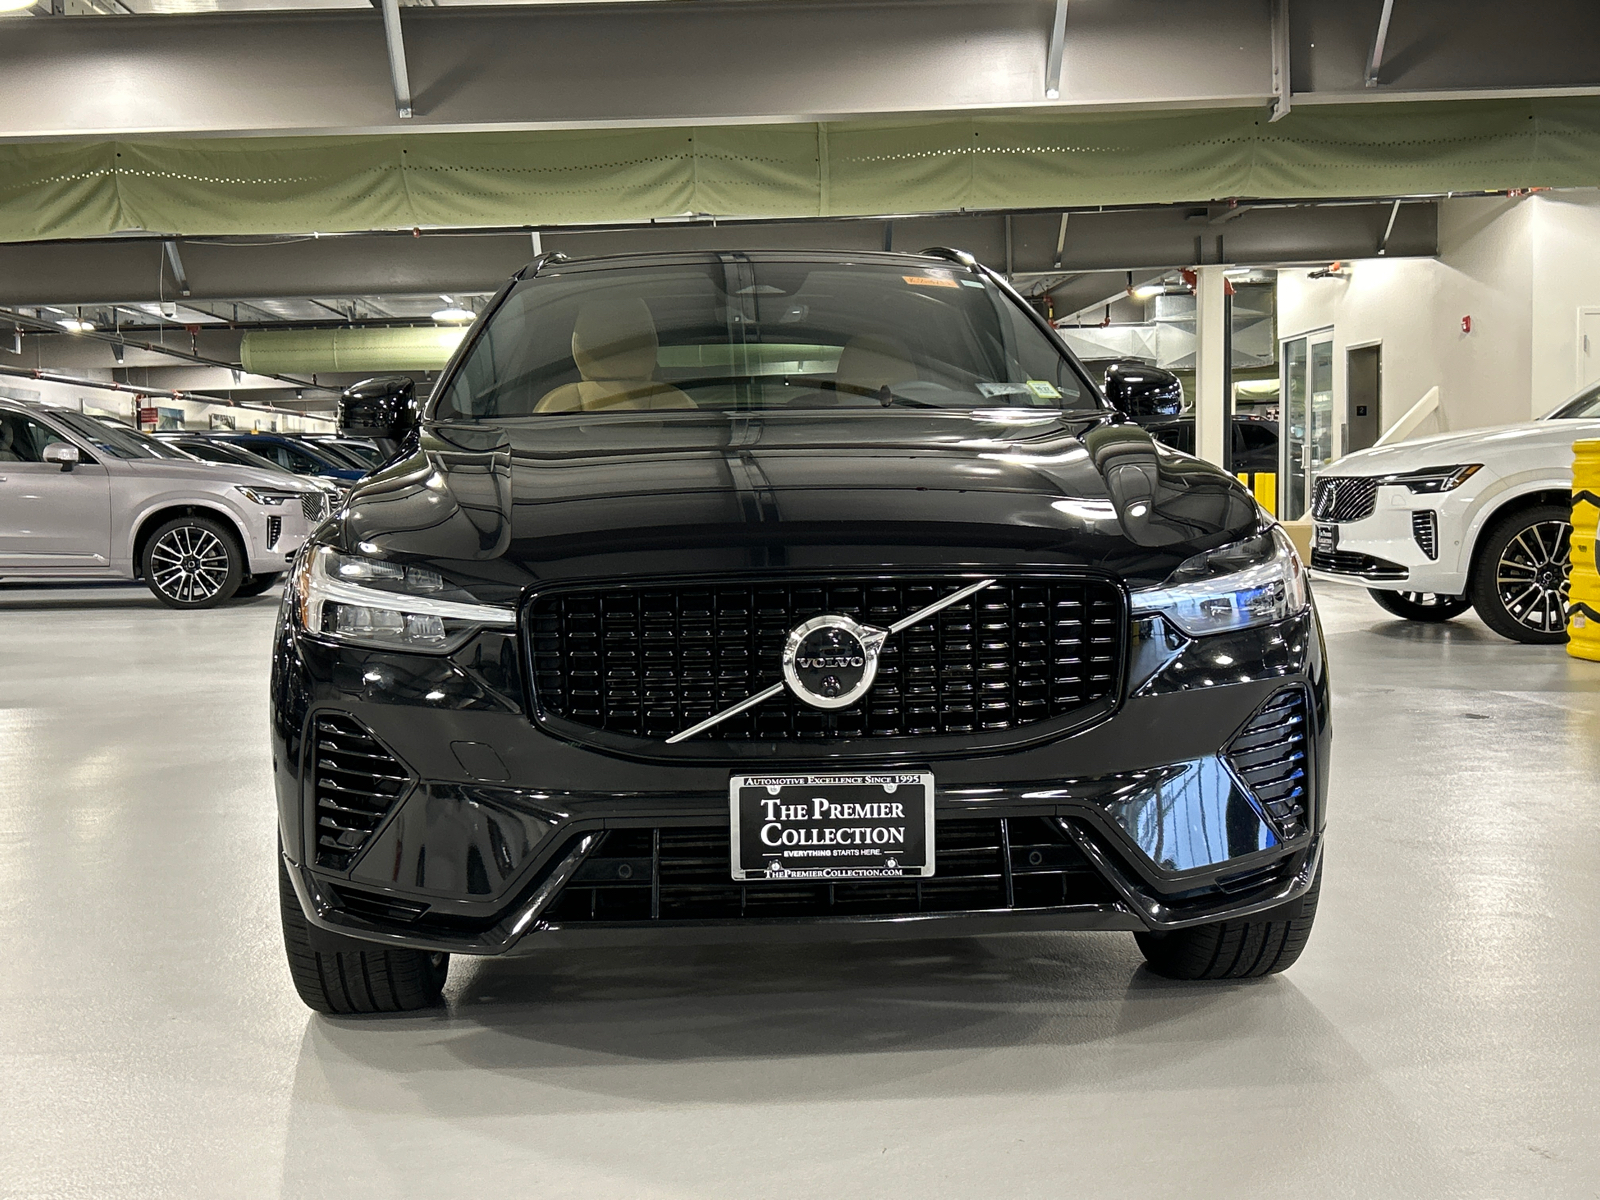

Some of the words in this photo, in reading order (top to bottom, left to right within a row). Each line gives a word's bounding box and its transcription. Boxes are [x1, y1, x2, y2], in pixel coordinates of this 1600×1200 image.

[797, 656, 864, 668] VOLVO
[745, 777, 805, 786] AUTOMOTIVE
[807, 775, 863, 784] EXCELLENCE
[864, 774, 892, 784] SINCE
[895, 774, 920, 783] 1995
[760, 798, 809, 821] THE
[811, 797, 906, 820] PREMIER
[760, 822, 906, 847] COLLECTION
[783, 849, 832, 858] EVERYTHING
[832, 848, 860, 857] STARTS
[860, 848, 882, 856] HERE.
[763, 868, 903, 879] THEPREMIERCOLLECTION.COM
